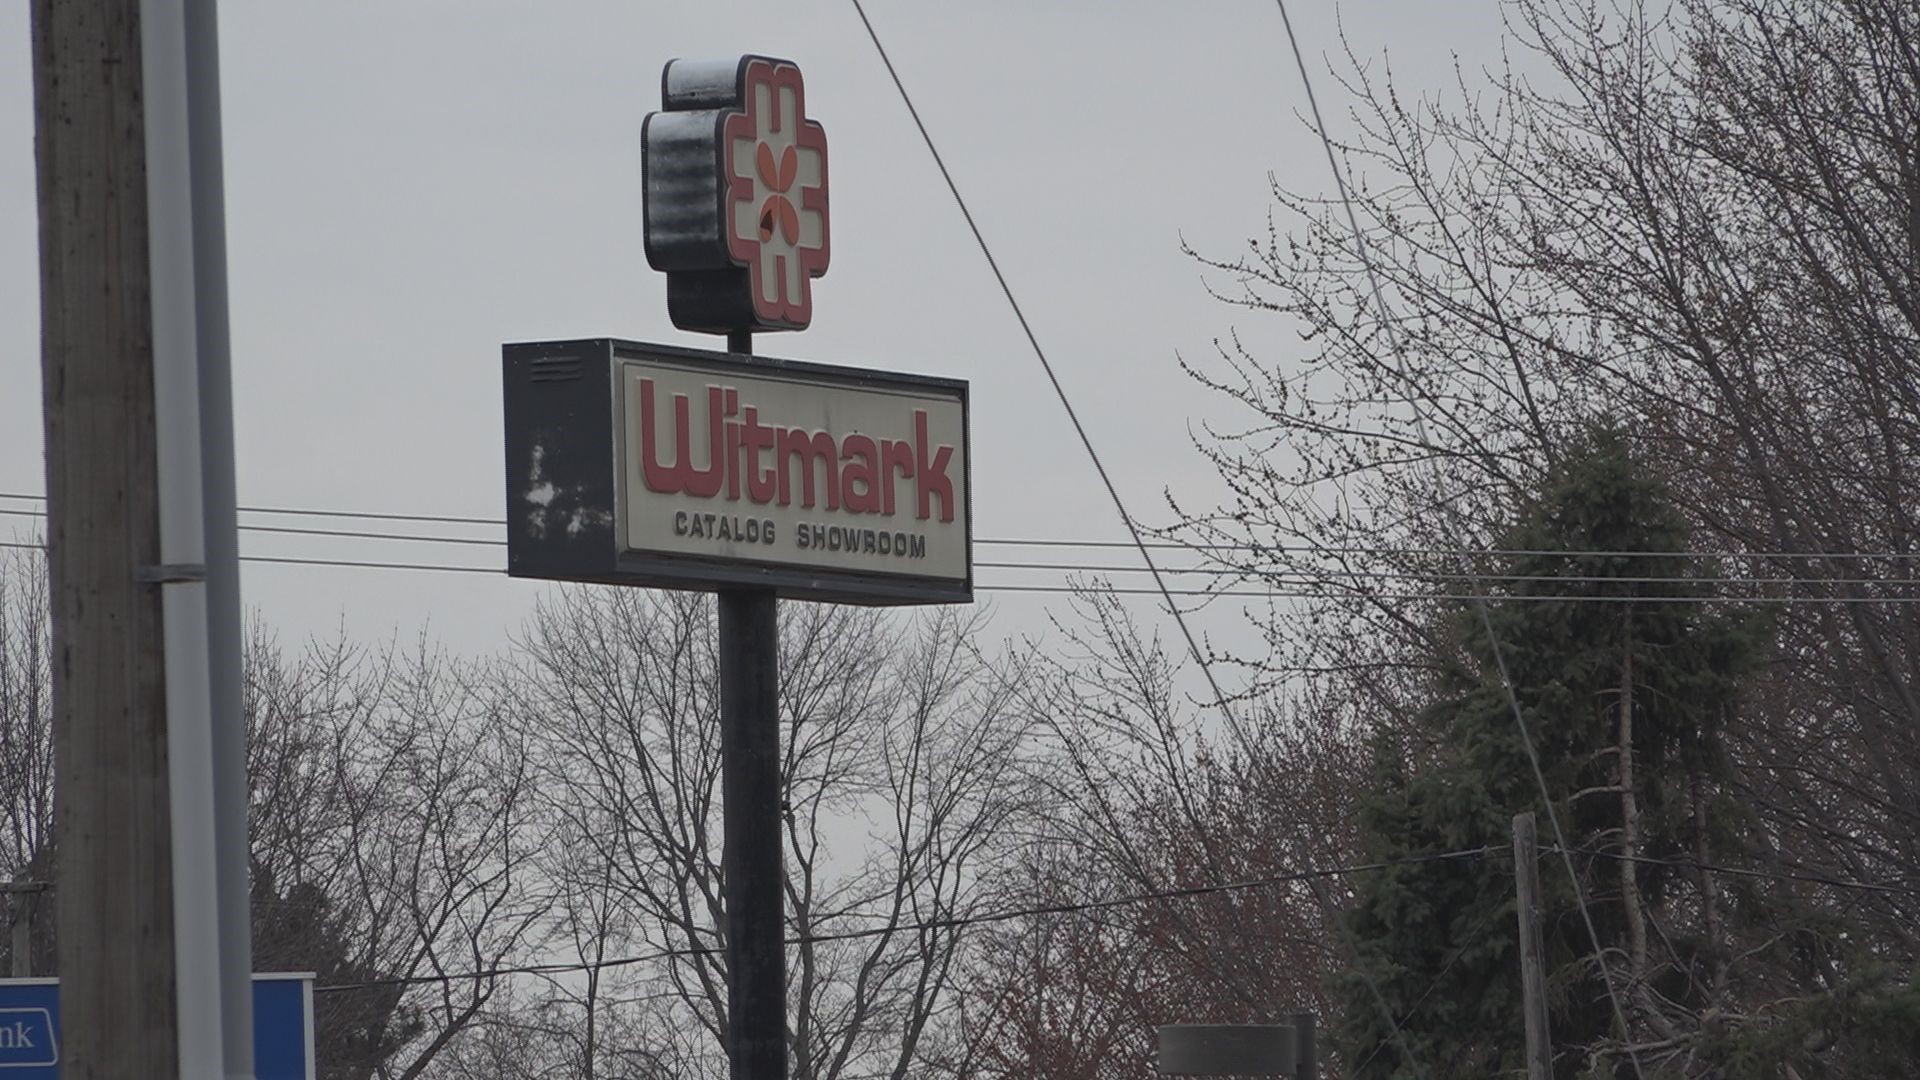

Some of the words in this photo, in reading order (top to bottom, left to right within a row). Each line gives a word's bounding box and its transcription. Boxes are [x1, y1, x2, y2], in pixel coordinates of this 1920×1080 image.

[639, 377, 955, 523] Witmark
[675, 510, 776, 545] CATALOG
[797, 523, 926, 559] SHOWROOM
